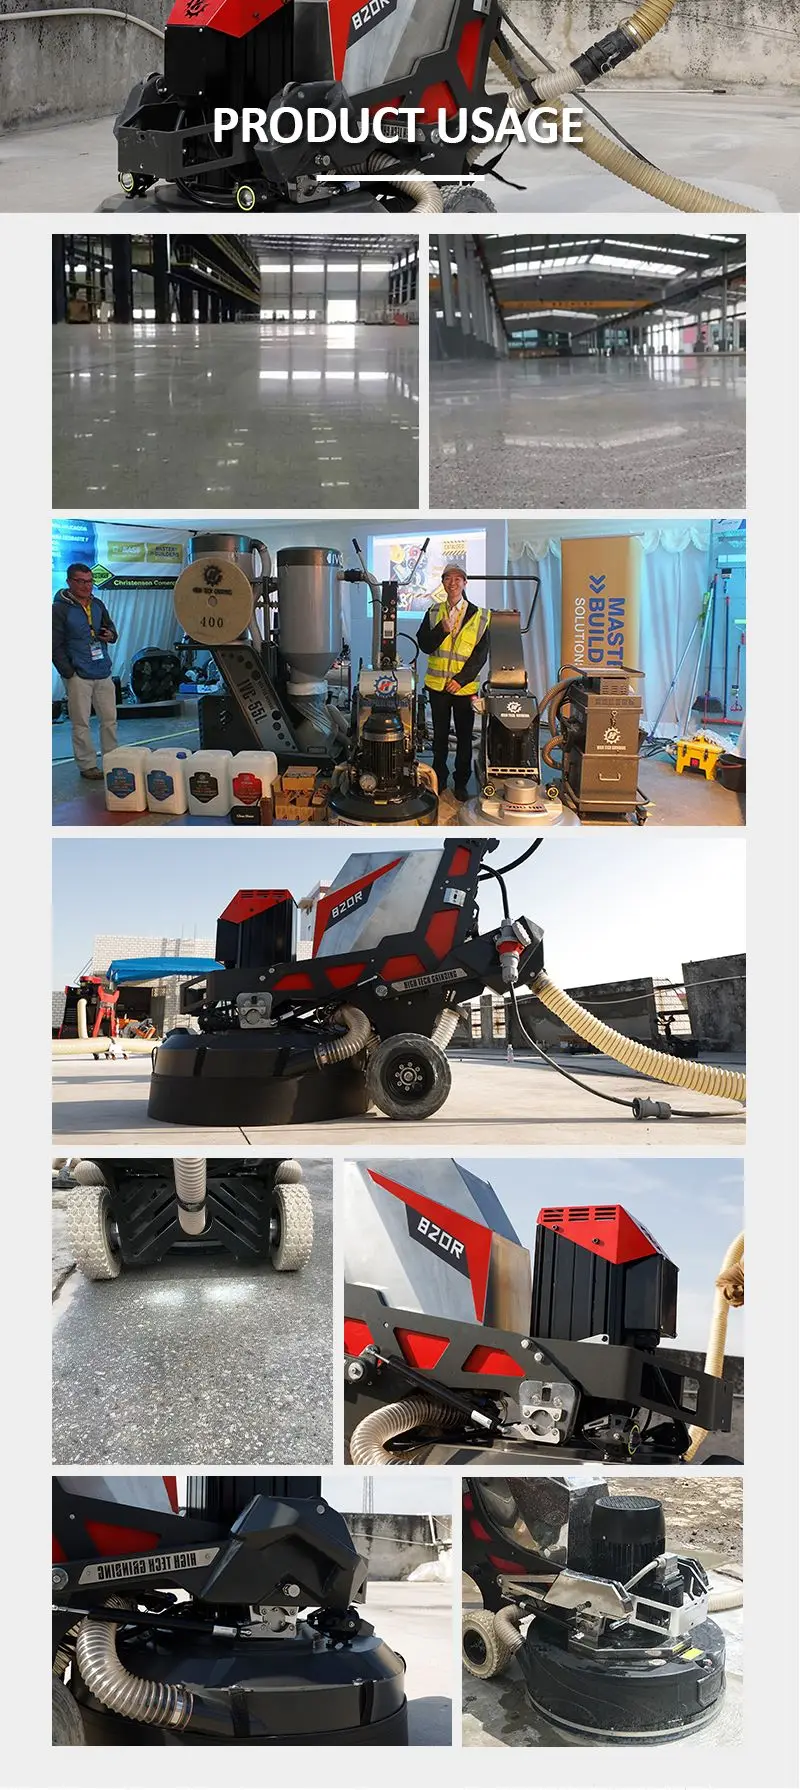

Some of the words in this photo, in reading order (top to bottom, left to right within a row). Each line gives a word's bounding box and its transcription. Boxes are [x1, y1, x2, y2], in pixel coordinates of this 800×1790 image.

[200, 616, 224, 629] 400
[574, 597, 586, 667] SOLUTION
[588, 597, 605, 663] BUILD
[331, 890, 363, 919] 820R
[403, 979, 418, 989] HIGH
[417, 975, 431, 986] TECH
[417, 1216, 465, 1260] 820R
